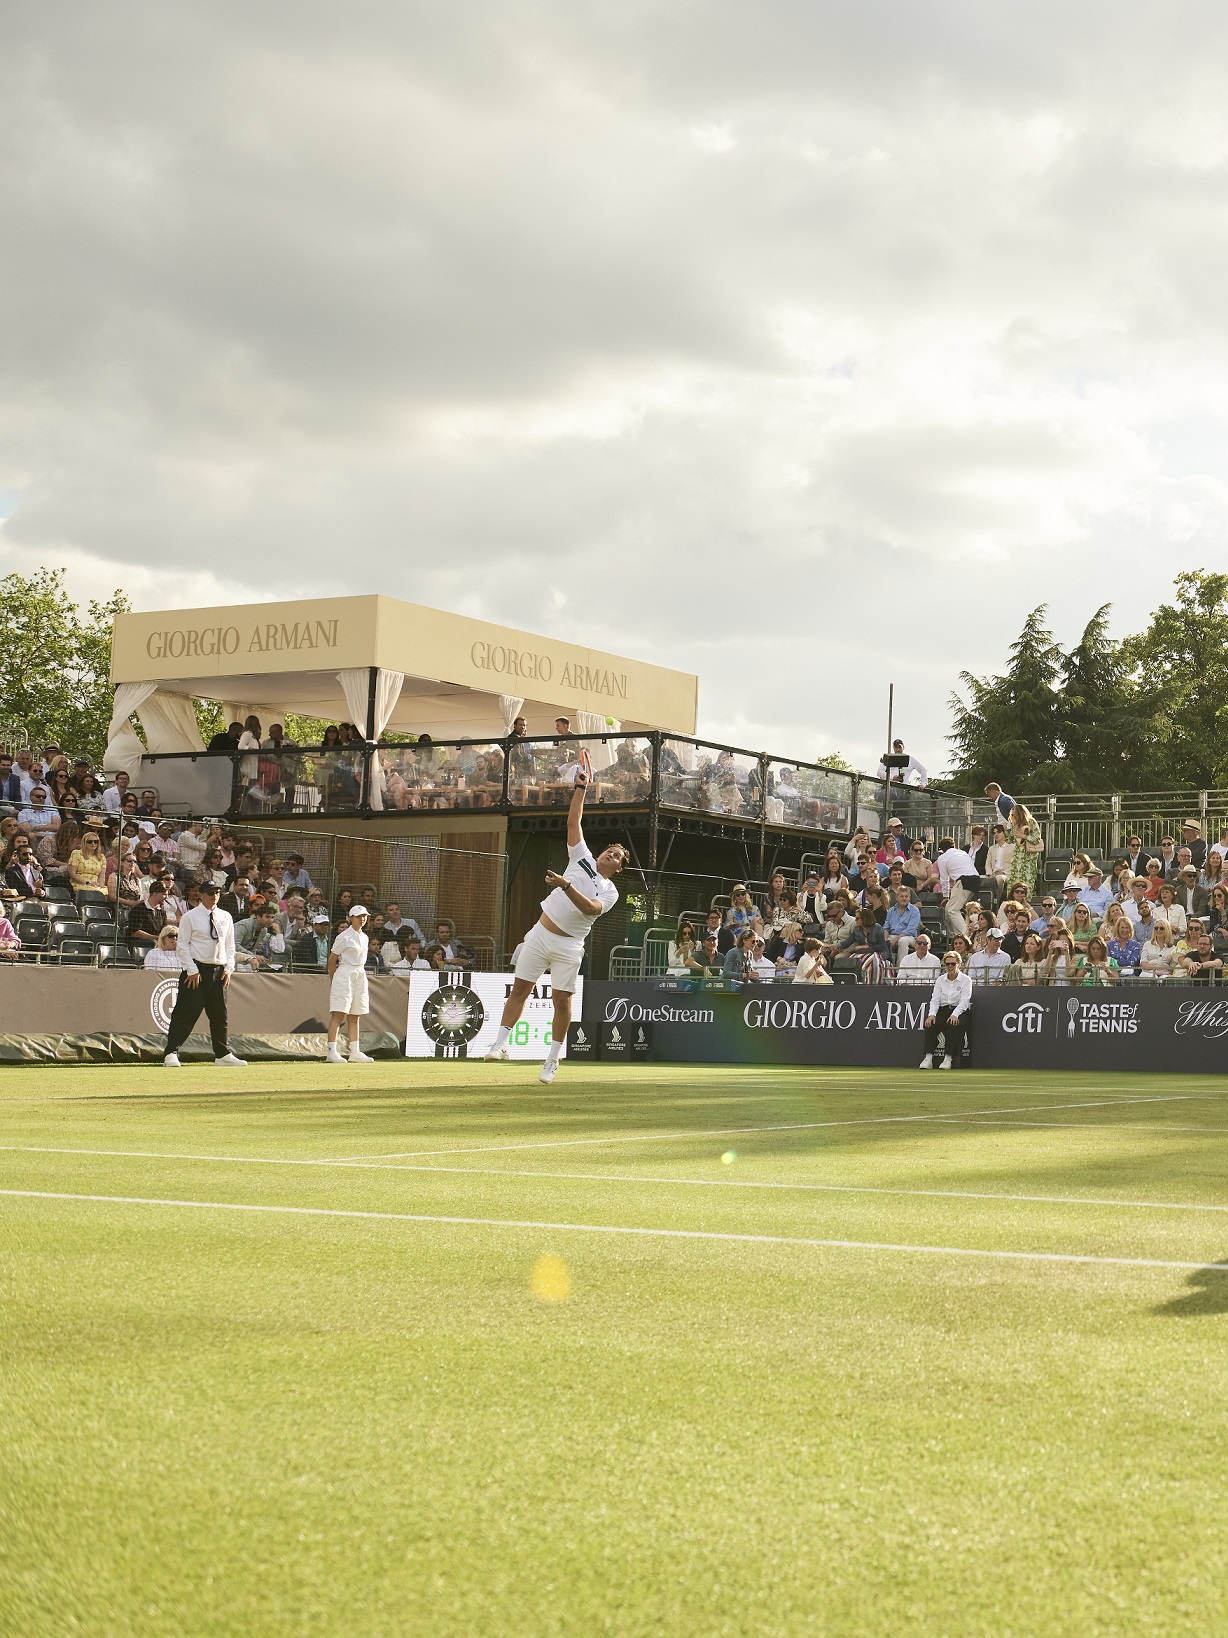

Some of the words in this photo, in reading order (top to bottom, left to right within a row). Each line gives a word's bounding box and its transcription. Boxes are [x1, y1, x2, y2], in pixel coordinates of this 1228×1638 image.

[146, 627, 240, 659] GIORGIO
[247, 619, 339, 652] ARMANI
[471, 641, 553, 682] GIORGIO
[559, 661, 629, 699] ARMANI
[629, 1003, 715, 1023] OneStream
[743, 999, 857, 1029] GIORGIO
[864, 1001, 927, 1031] ARM
[1080, 1003, 1128, 1018] TASTE
[1080, 1019, 1138, 1033] TENNIS
